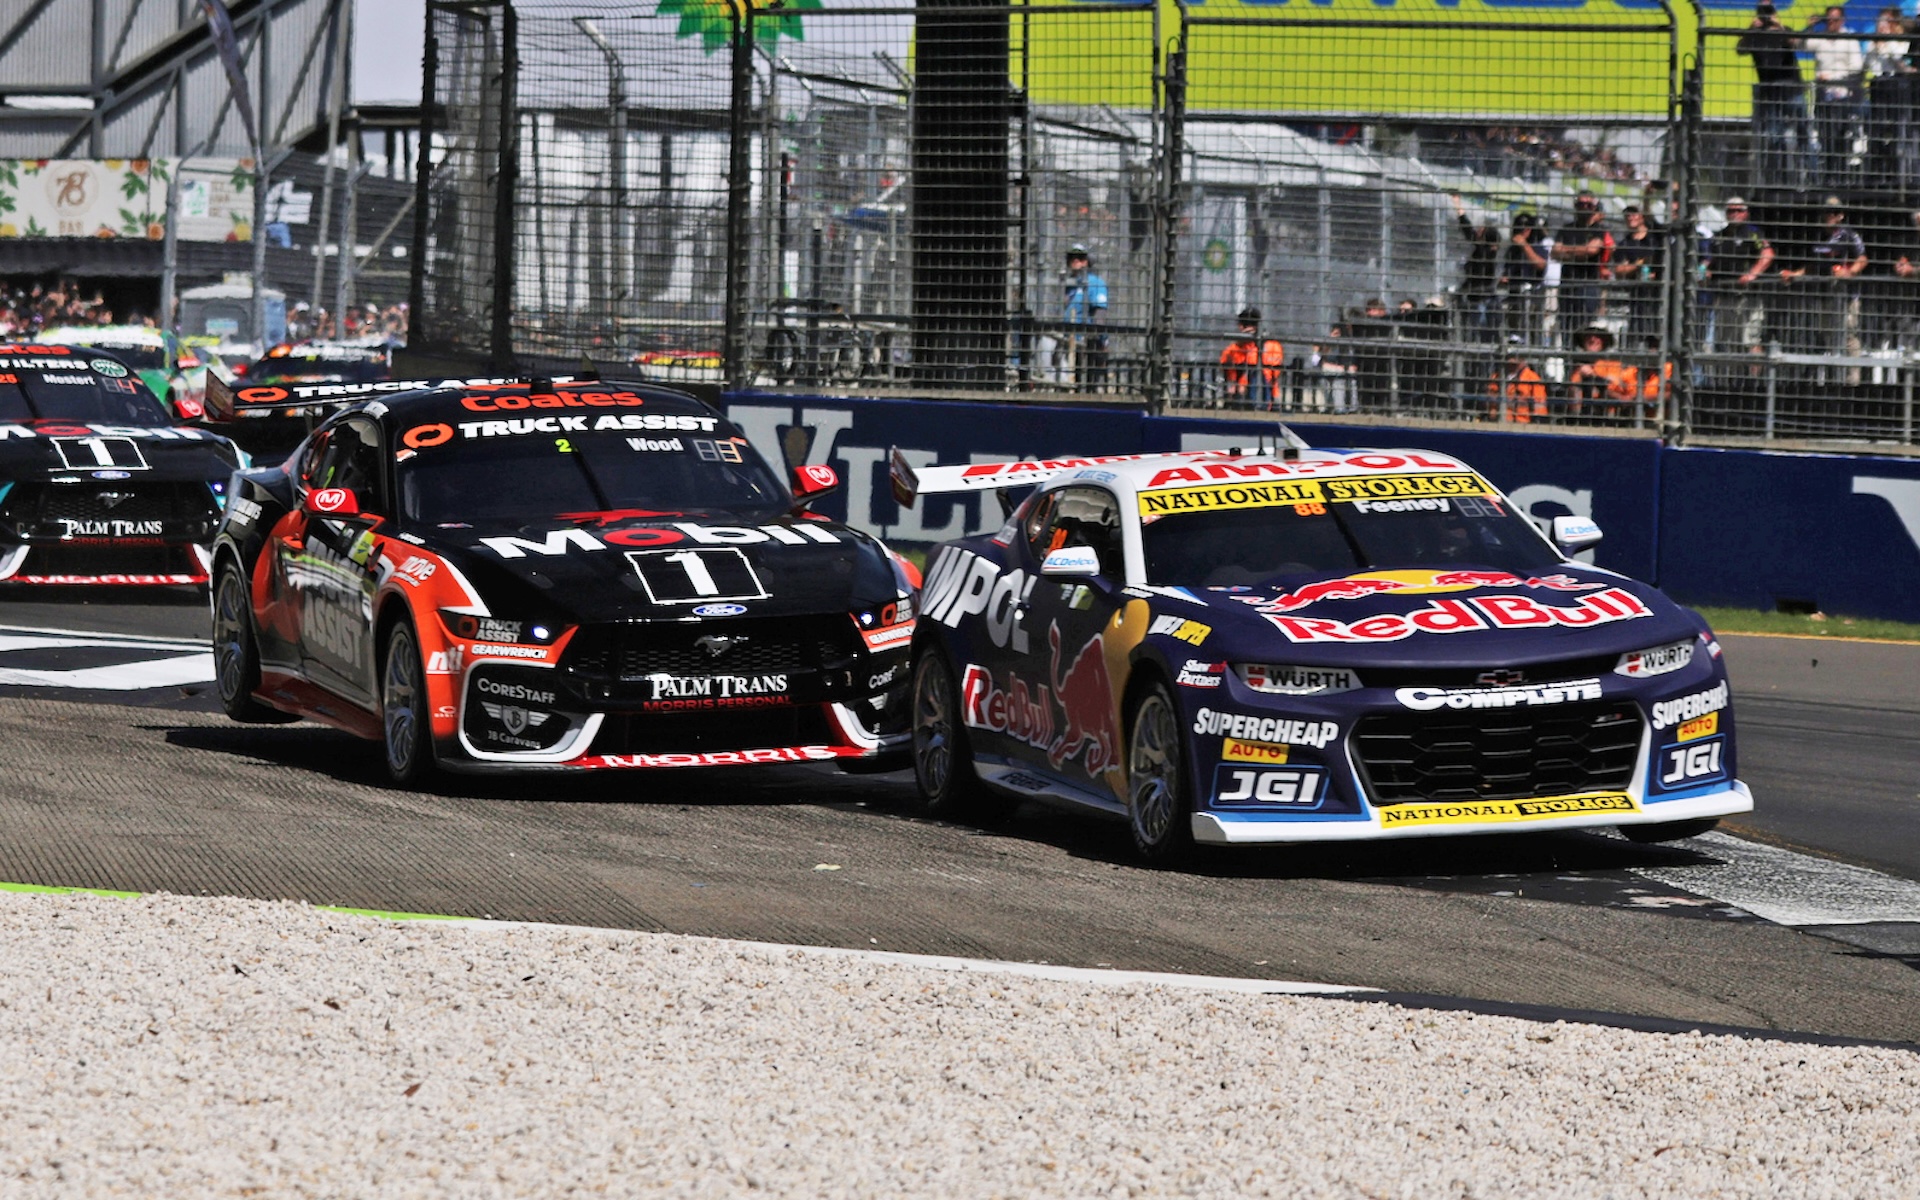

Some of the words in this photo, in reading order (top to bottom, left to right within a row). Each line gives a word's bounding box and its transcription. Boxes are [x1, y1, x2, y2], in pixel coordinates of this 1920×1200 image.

[43, 374, 96, 385] Mostert
[293, 381, 430, 398] TRUCK
[459, 416, 588, 439] TRUCK
[594, 415, 718, 432] ASSIST
[78, 437, 114, 467] 1
[625, 437, 684, 453] Wood
[1147, 455, 1458, 488] AMPOL
[1144, 484, 1316, 513] NATIONAL
[1326, 477, 1480, 499] STORAGE
[1353, 498, 1451, 513] Feeney
[1293, 502, 1327, 516] 88
[67, 520, 109, 535] PALM
[111, 520, 163, 536] TRANS
[479, 523, 841, 559] Mobil
[665, 552, 720, 596] 1
[479, 617, 523, 632] TRUCK
[1260, 599, 1491, 643] Red
[1467, 587, 1654, 628] Bull
[304, 592, 362, 669] ASSIST
[475, 629, 521, 643] ASSIST
[471, 644, 548, 659] GEARWRENCH
[651, 675, 711, 699] PALM
[716, 675, 788, 697] TRANS
[1269, 670, 1350, 688] WÜRTH
[643, 699, 714, 711] MORRIS
[717, 695, 792, 709] PERSONAL
[1395, 682, 1603, 711] COMPLETE
[1193, 707, 1339, 749] SUPERCHEAP
[1682, 718, 1713, 736] AUTO
[600, 745, 839, 769] MORRIS
[1229, 743, 1281, 758] AUTO
[1663, 742, 1722, 783] JGI
[1218, 770, 1320, 803] JGI
[1385, 804, 1513, 822] NATIONAL
[1523, 795, 1632, 814] STORAGE
